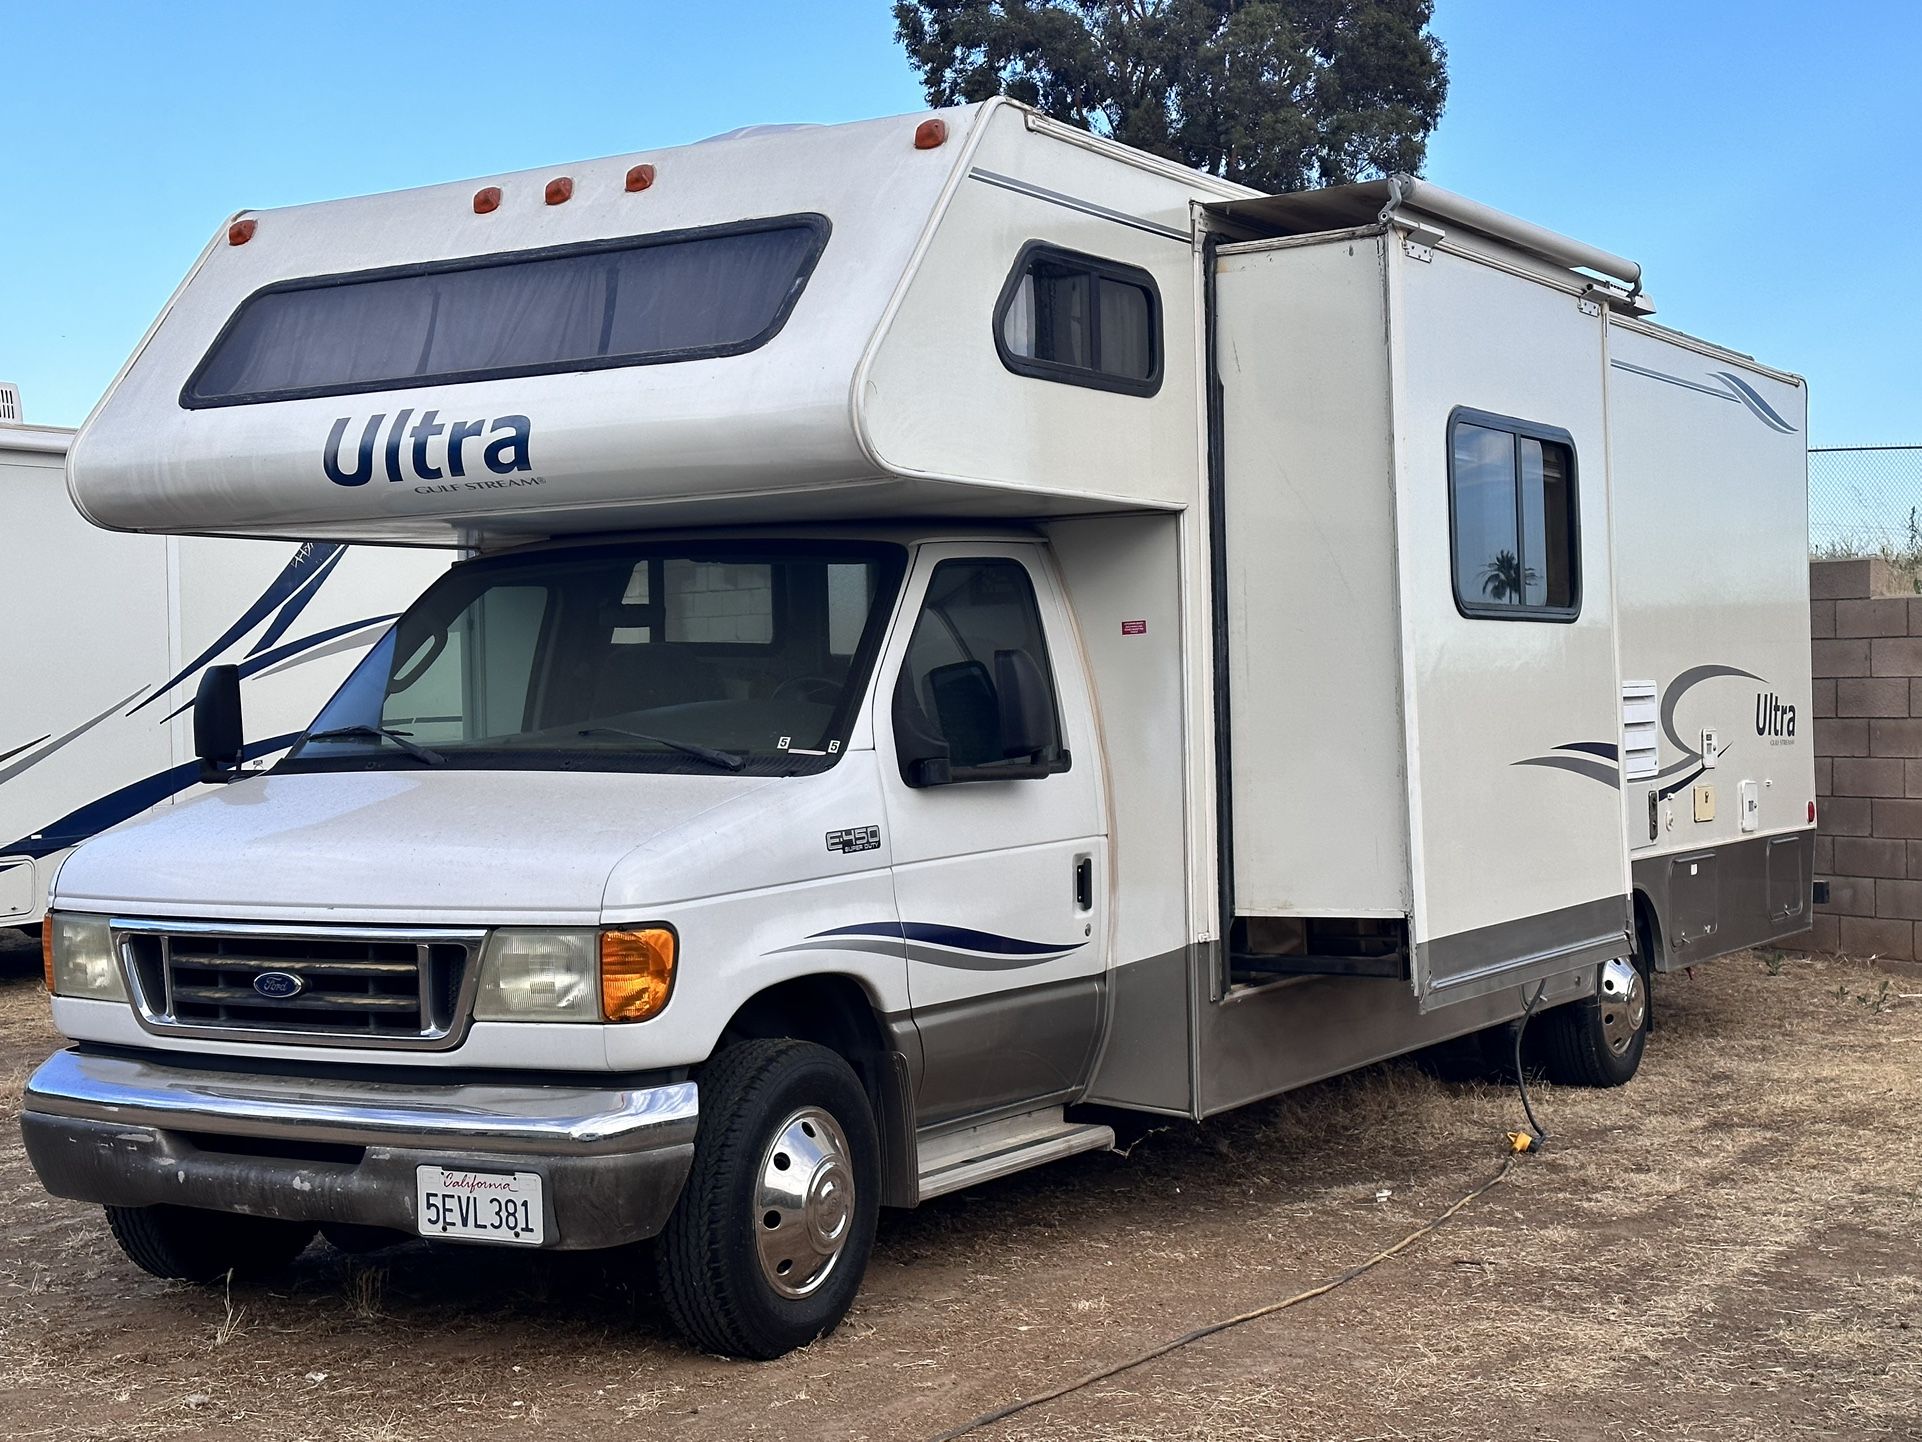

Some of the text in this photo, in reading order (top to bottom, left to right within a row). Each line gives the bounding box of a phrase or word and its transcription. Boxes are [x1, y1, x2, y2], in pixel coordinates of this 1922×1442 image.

[323, 408, 532, 487] Ultra
[414, 483, 460, 495] GULF
[1756, 692, 1796, 737] Ultra
[779, 737, 789, 747] 5
[830, 741, 839, 751] 5
[264, 976, 288, 991] Ford
[443, 1172, 519, 1194] California
[425, 1192, 535, 1233] 5EVL381
